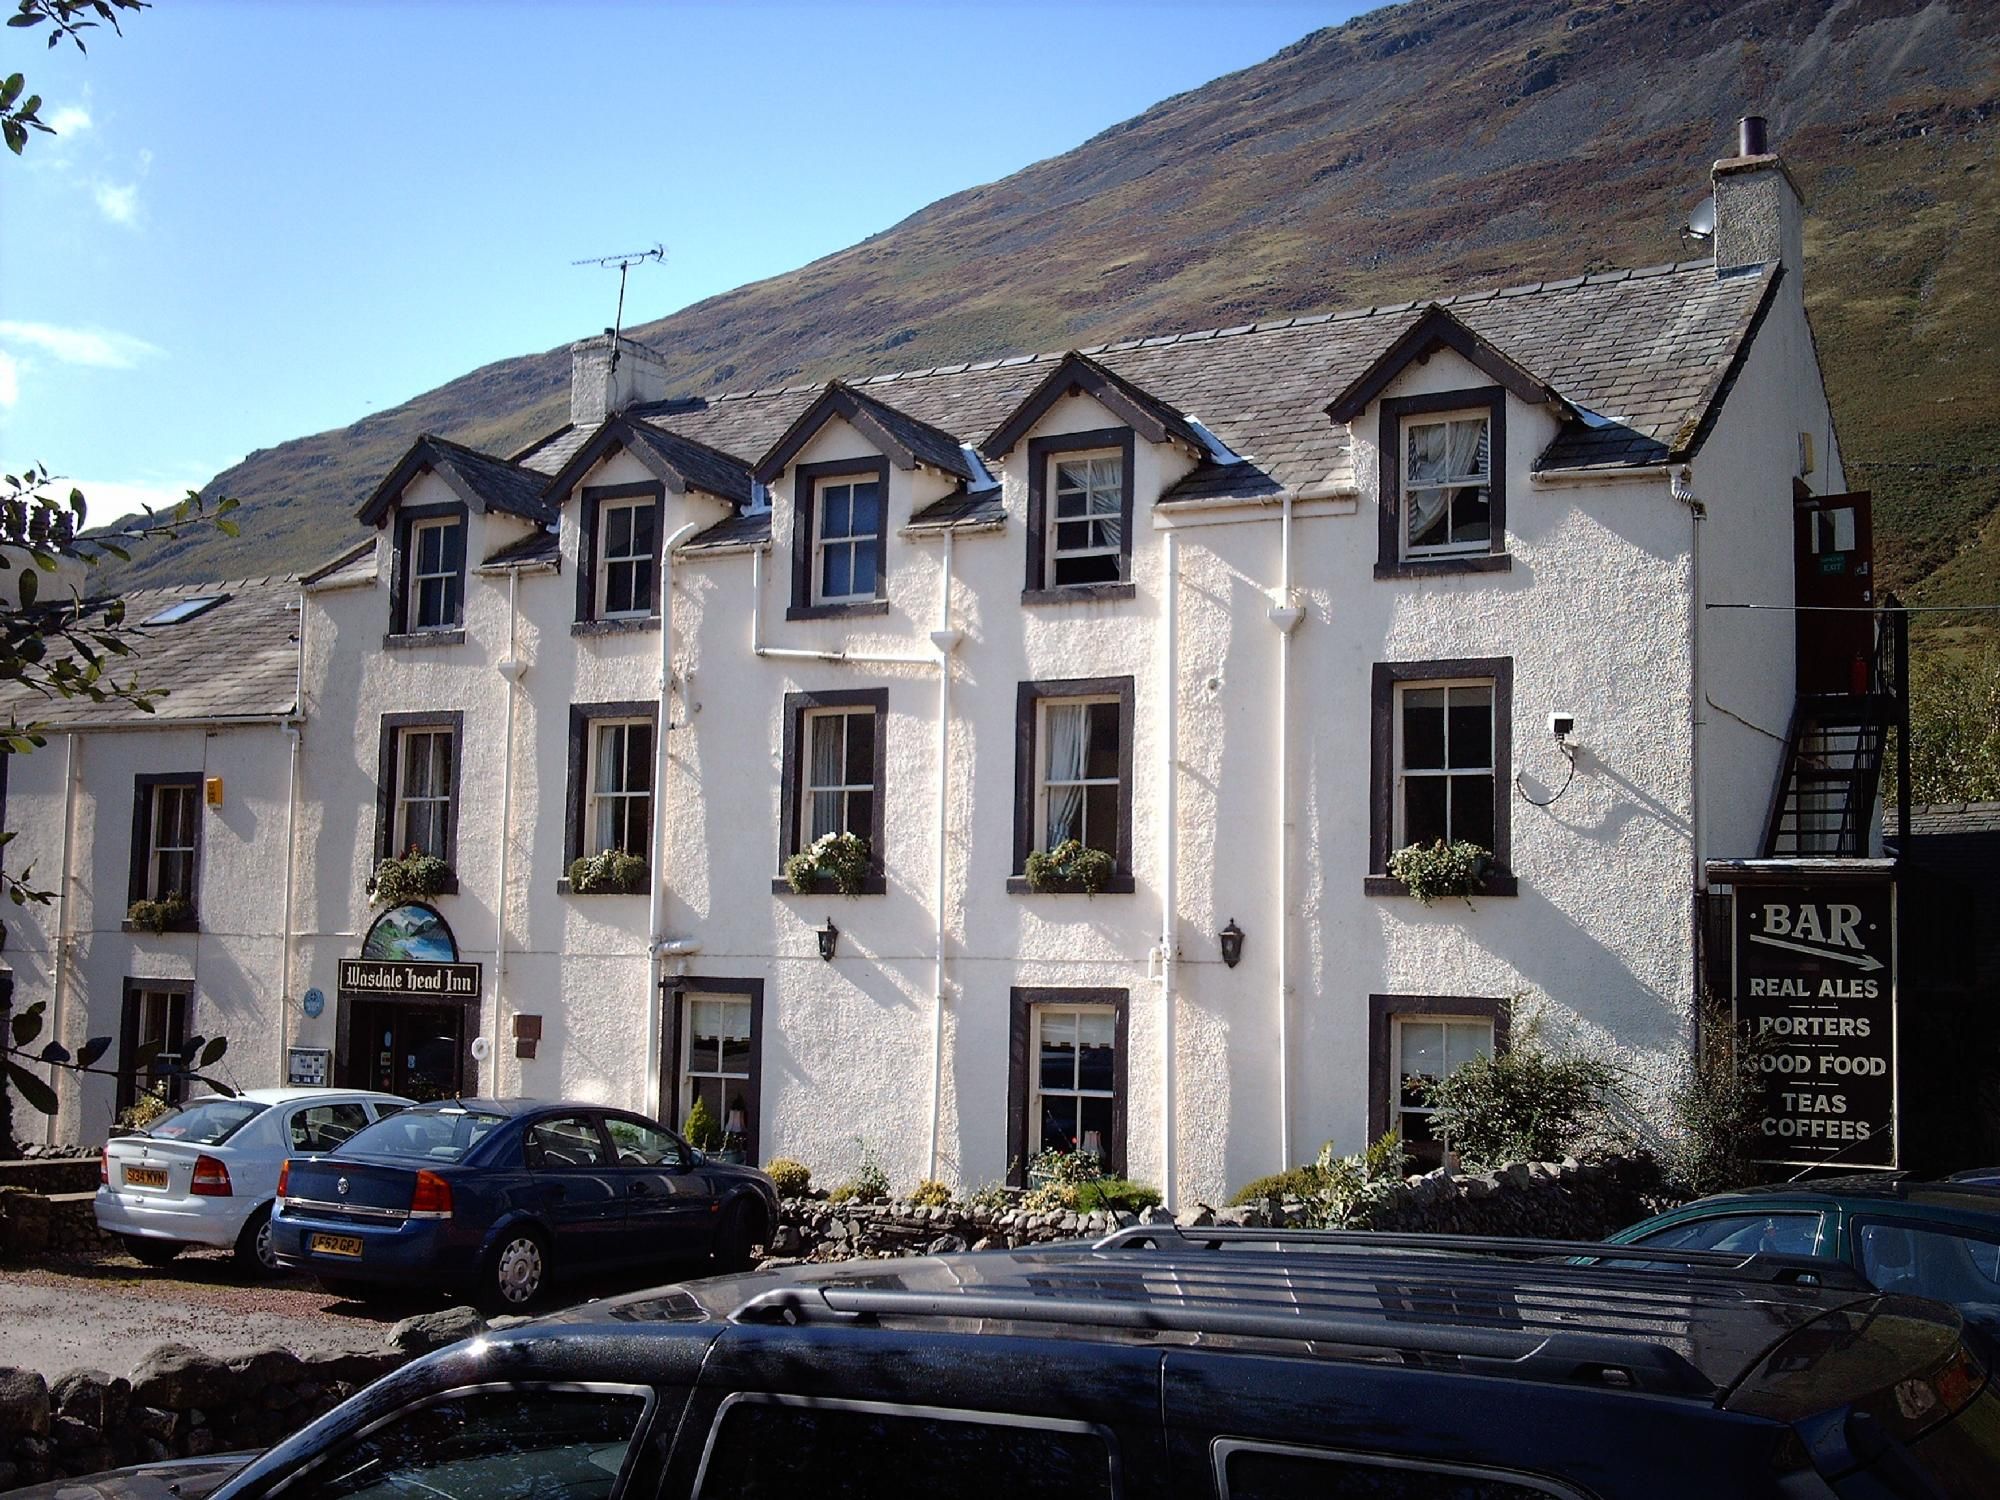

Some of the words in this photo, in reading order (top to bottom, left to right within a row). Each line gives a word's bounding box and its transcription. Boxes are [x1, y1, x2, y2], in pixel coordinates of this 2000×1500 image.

[1763, 904, 1865, 949] BAR
[346, 966, 402, 988] Wasdale
[444, 969, 471, 992] Inn
[1750, 978, 1810, 997] REAL
[1818, 979, 1879, 999] ALES
[1759, 1016, 1871, 1037] PORTERS
[1819, 1055, 1886, 1076] FOOD
[1781, 1093, 1847, 1113] TEAS
[1761, 1117, 1871, 1140] COFFEES
